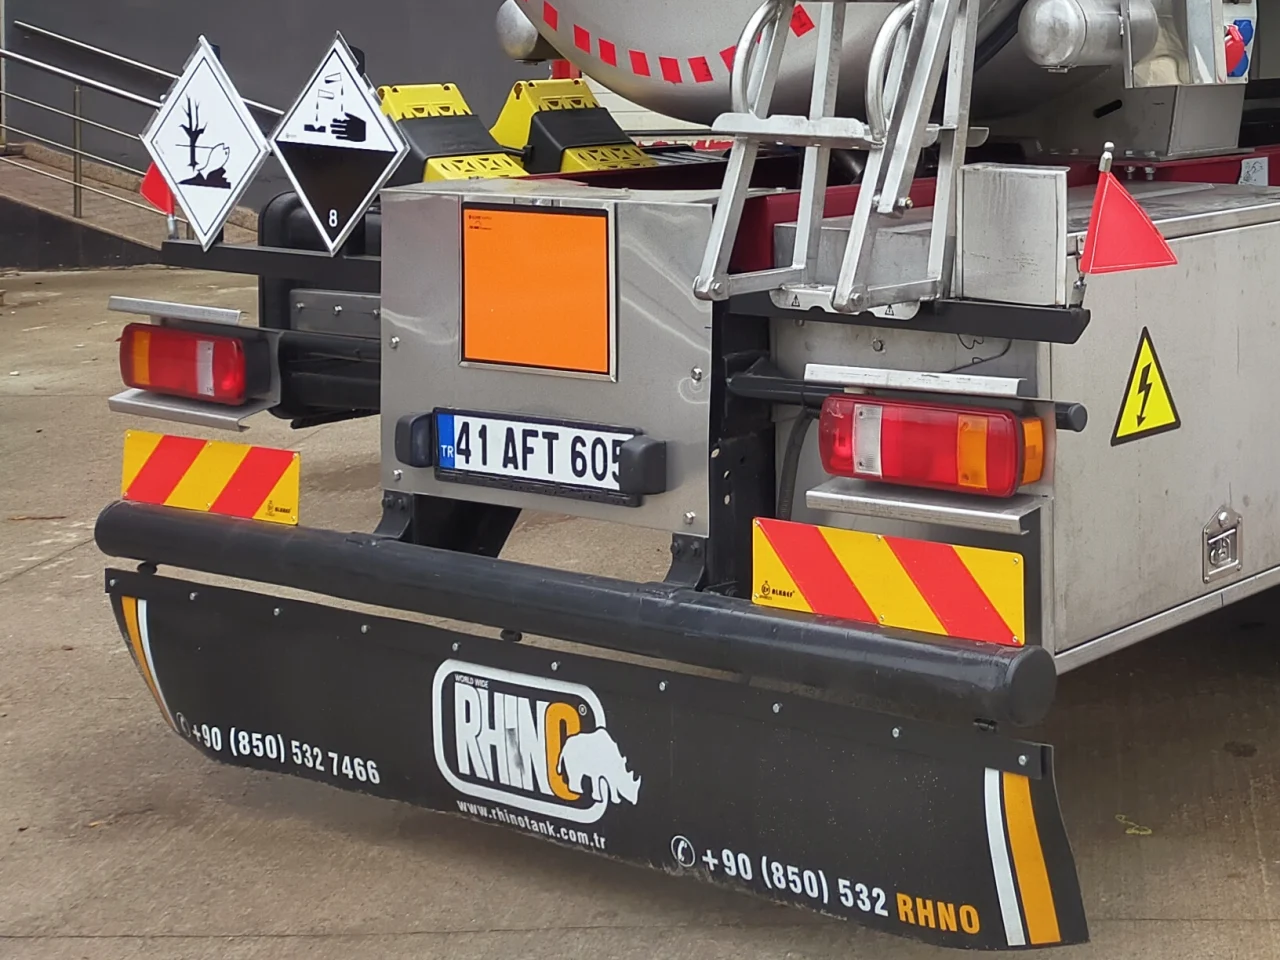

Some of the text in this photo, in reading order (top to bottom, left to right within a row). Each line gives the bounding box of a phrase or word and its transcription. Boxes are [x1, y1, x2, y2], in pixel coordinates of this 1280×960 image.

[329, 209, 338, 227] 8
[441, 445, 454, 458] TR
[456, 421, 488, 466] 41
[502, 427, 560, 474] AFT
[454, 673, 489, 689] WORLD WIDE
[191, 723, 381, 785] +90 (850) 532 7466
[455, 682, 582, 801] RHINO
[456, 800, 606, 849] www.rhinotank.com.tr
[702, 848, 981, 935] +90 (850) 532 RHNO
